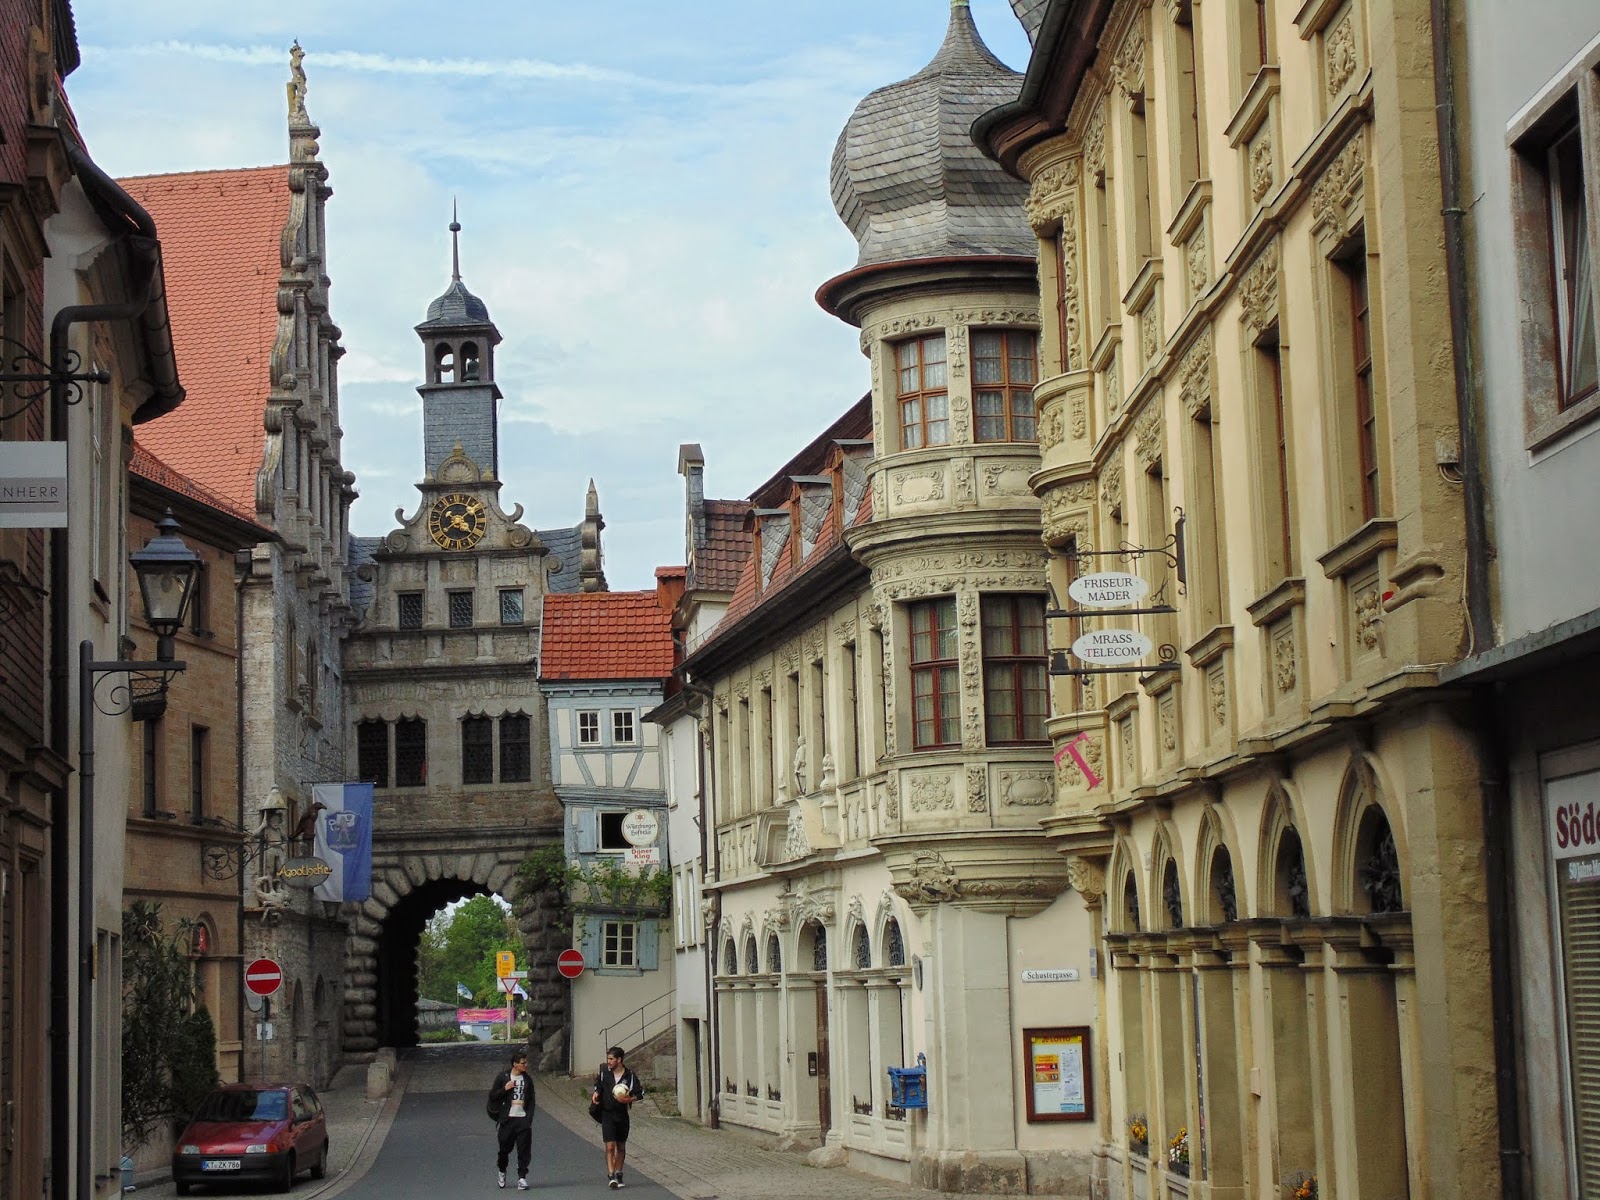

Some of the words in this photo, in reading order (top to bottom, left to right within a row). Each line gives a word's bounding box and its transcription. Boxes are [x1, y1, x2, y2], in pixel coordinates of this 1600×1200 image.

[3, 486, 58, 498] NHERR
[1084, 578, 1133, 588] FRISEUR
[1088, 589, 1130, 601] MÄDER
[1092, 634, 1132, 644] MRASS
[1085, 647, 1141, 657] TELECOM
[1053, 731, 1104, 791] T
[277, 863, 332, 880] Apotheke
[1027, 971, 1073, 980] Schustergasse
